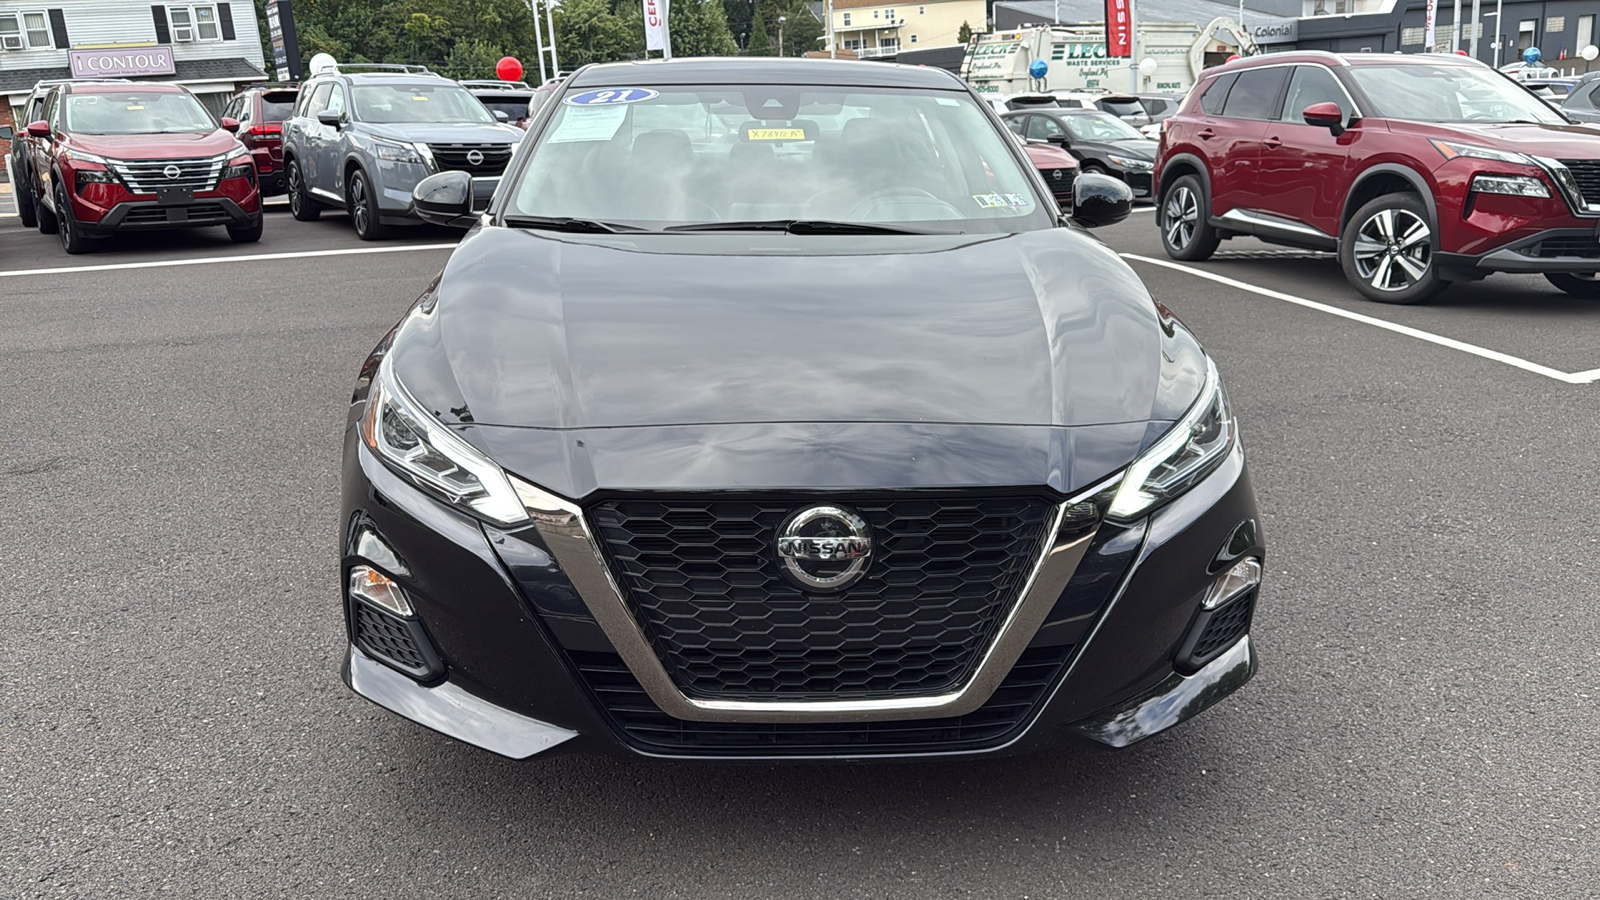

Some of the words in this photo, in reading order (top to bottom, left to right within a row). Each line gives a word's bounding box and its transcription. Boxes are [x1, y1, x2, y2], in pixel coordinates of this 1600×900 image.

[1255, 25, 1293, 37] Colonial
[975, 43, 1012, 56] LECK
[1067, 43, 1109, 59] LEC
[87, 54, 167, 71] CONTOUR
[588, 89, 634, 104] 21
[788, 542, 861, 555] NISSAN
